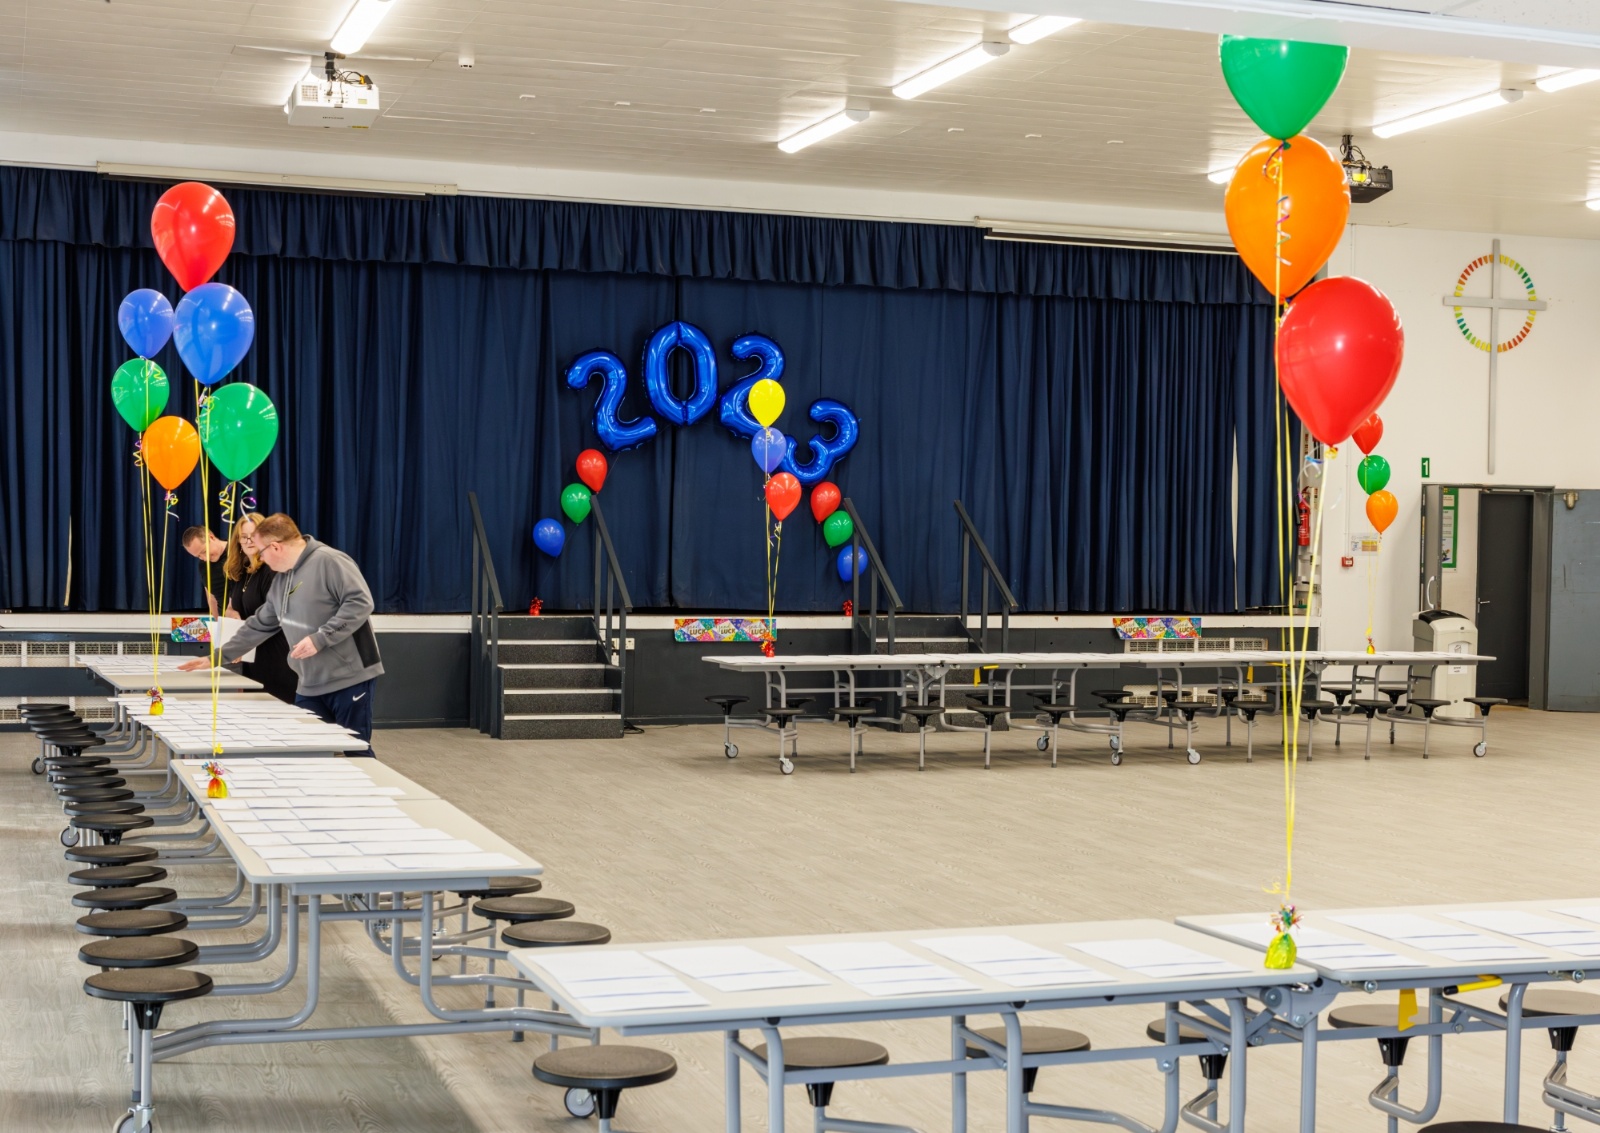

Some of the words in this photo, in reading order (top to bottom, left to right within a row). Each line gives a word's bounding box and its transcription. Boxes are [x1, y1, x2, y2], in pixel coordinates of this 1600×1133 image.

[565, 319, 860, 487] 2023
[1423, 460, 1429, 476] 1
[689, 628, 706, 636] LUCK
